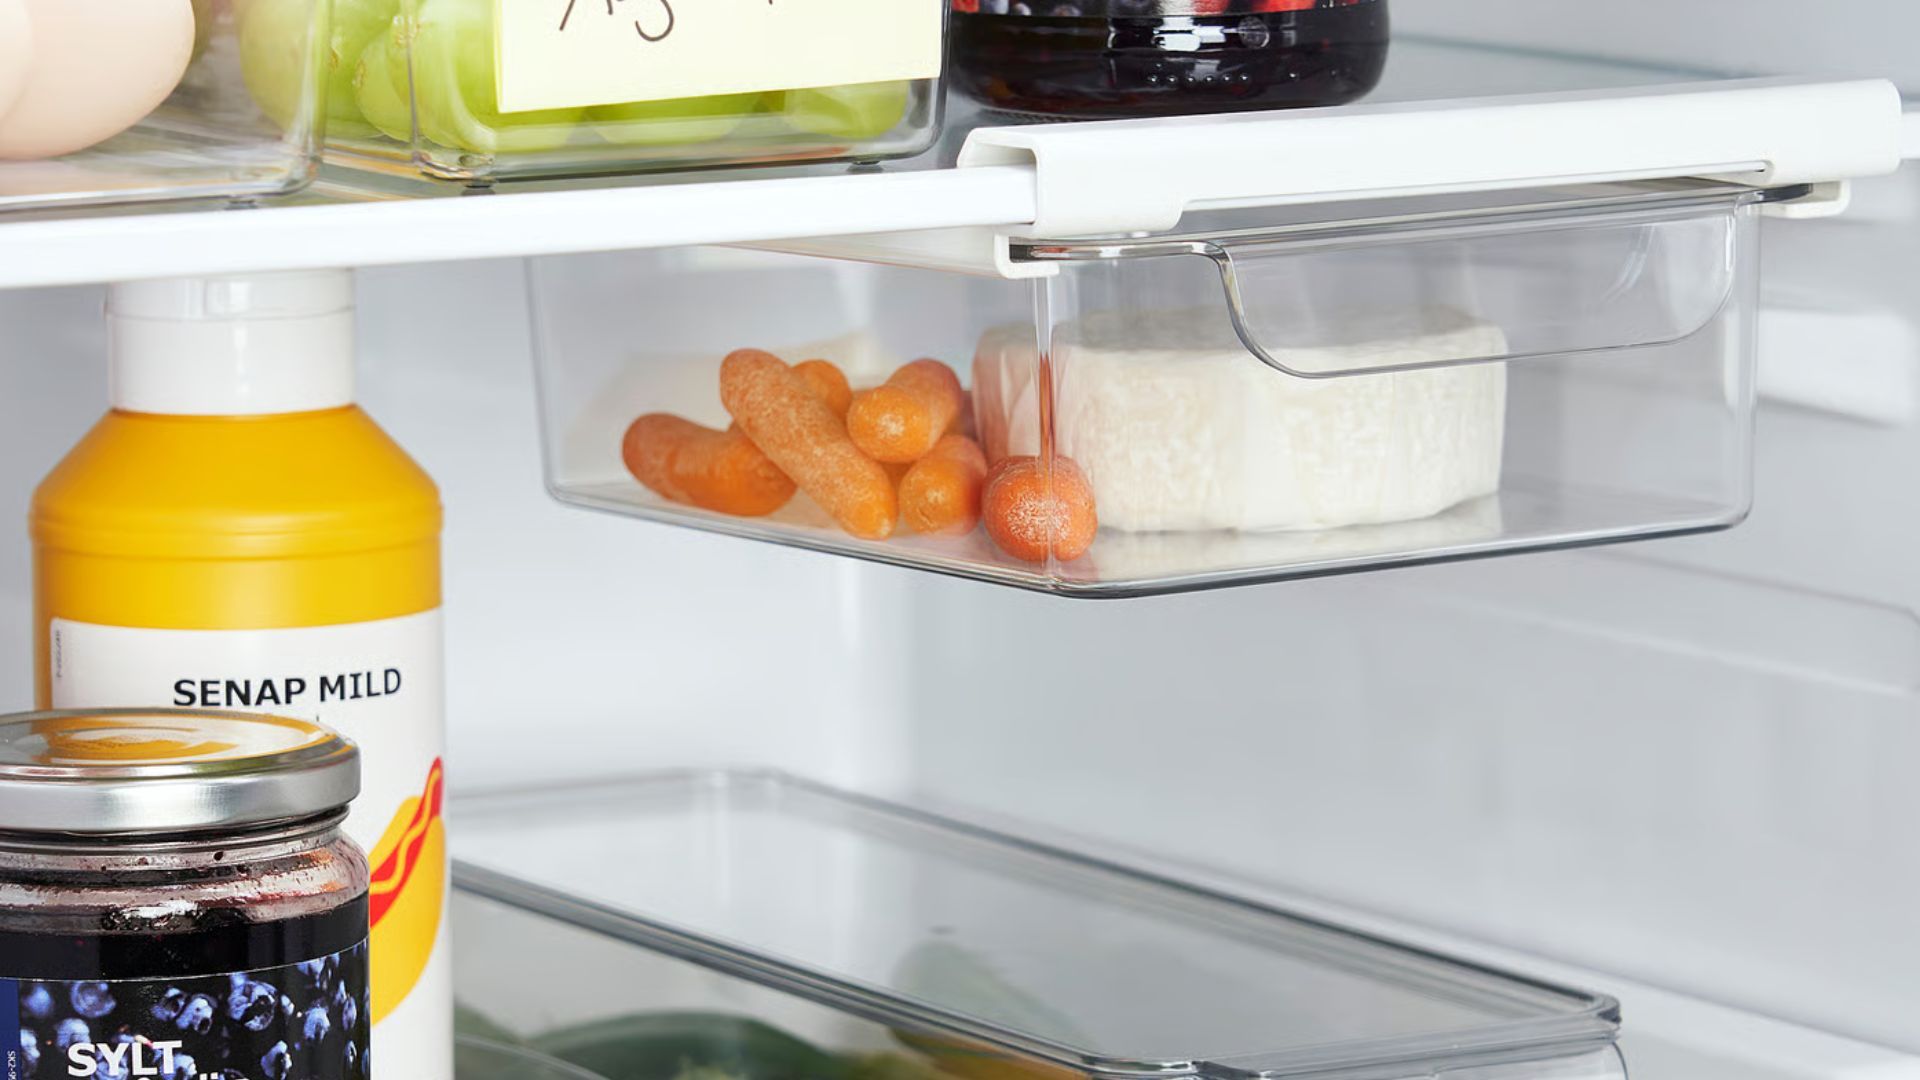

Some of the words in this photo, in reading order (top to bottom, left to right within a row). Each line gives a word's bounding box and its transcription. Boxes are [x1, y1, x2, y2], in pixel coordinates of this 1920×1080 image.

[173, 679, 306, 707] SENAP
[319, 668, 402, 702] MILD
[67, 1040, 182, 1077] SYLT
